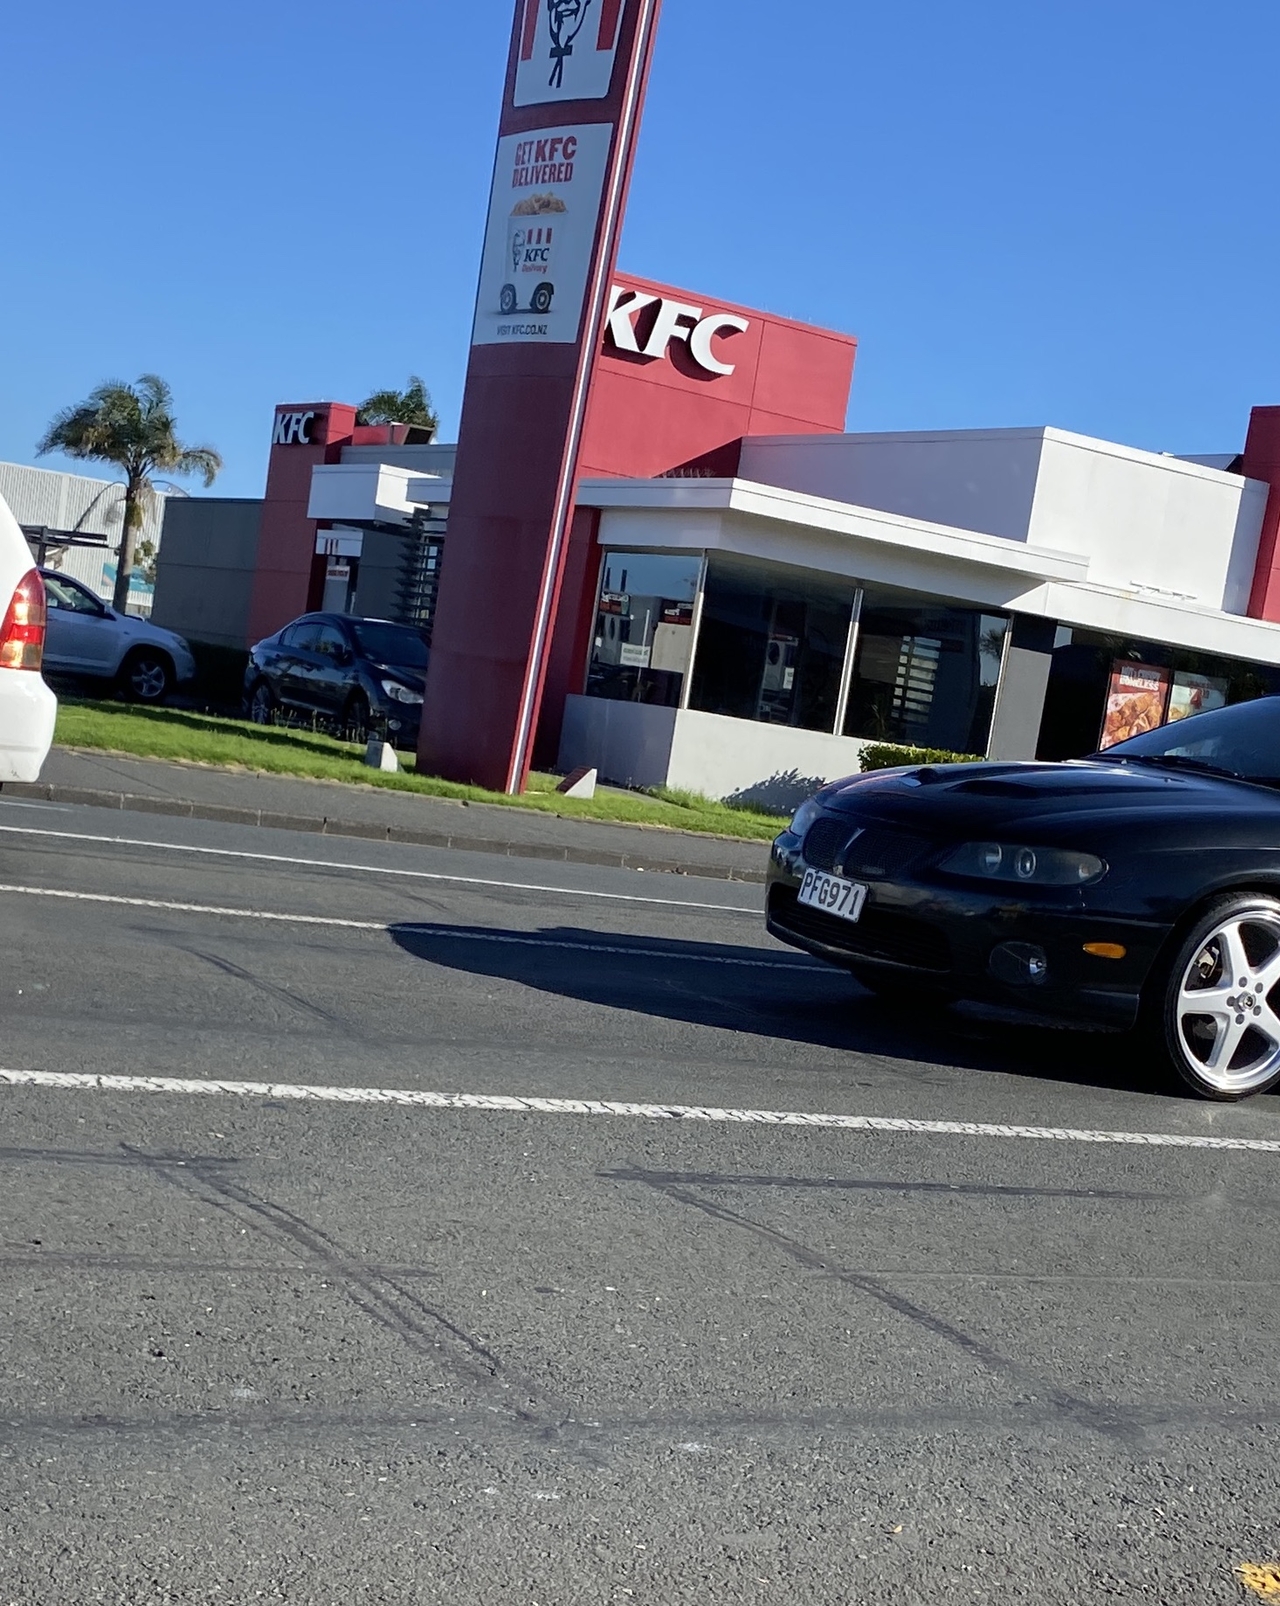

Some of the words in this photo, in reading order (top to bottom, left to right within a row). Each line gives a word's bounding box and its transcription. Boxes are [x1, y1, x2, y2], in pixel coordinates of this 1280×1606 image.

[514, 140, 534, 166] GET
[535, 136, 577, 161] KFC
[512, 162, 574, 188] DELIVERED
[524, 248, 550, 262] KFC
[602, 284, 750, 376] KFC
[272, 411, 315, 444] KFC
[800, 872, 860, 915] PFG971
